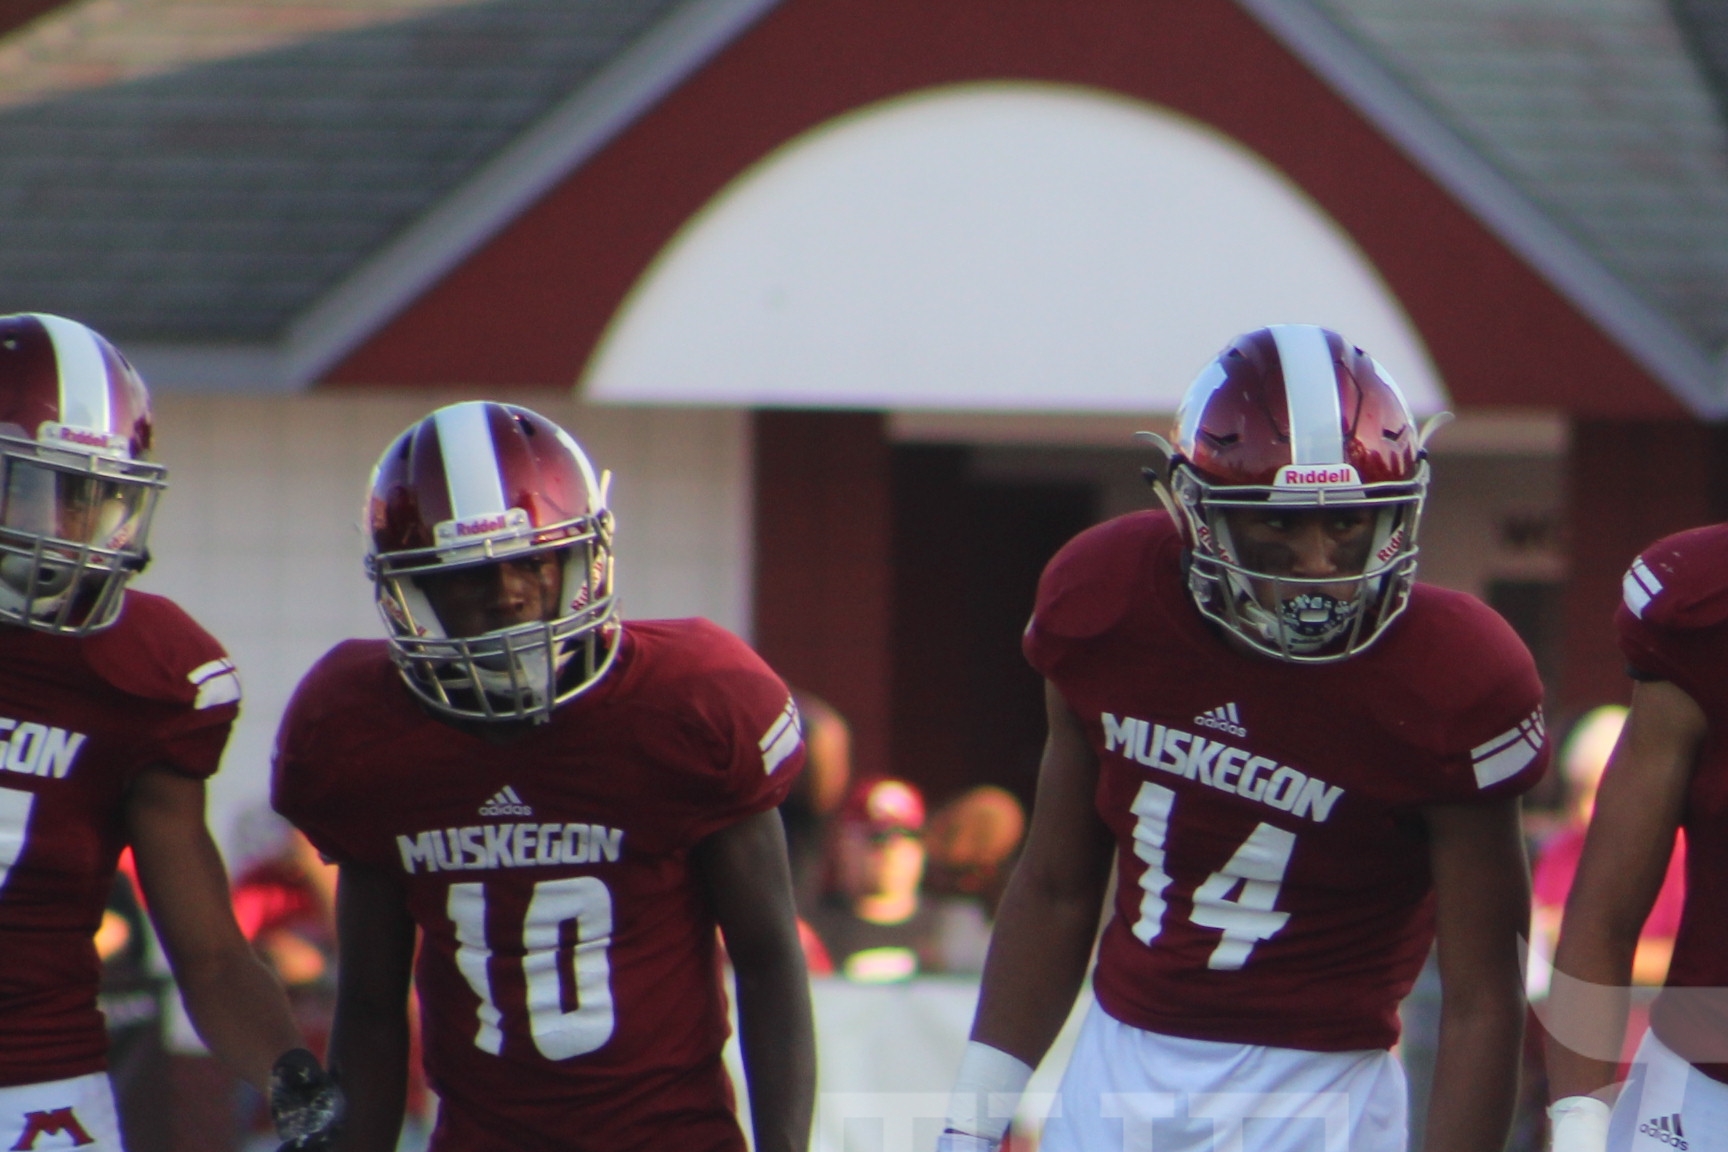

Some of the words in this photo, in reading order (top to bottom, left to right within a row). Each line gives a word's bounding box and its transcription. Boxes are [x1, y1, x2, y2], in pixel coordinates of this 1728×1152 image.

[1285, 469, 1351, 484] Riddell
[1194, 714, 1247, 738] adidas
[1101, 711, 1345, 823] MUSKEGON
[479, 801, 533, 816] adidas
[396, 822, 625, 875] MUSKEGON
[1129, 780, 1297, 971] 14
[447, 875, 615, 1061] 10
[1639, 1122, 1689, 1152] adidas
